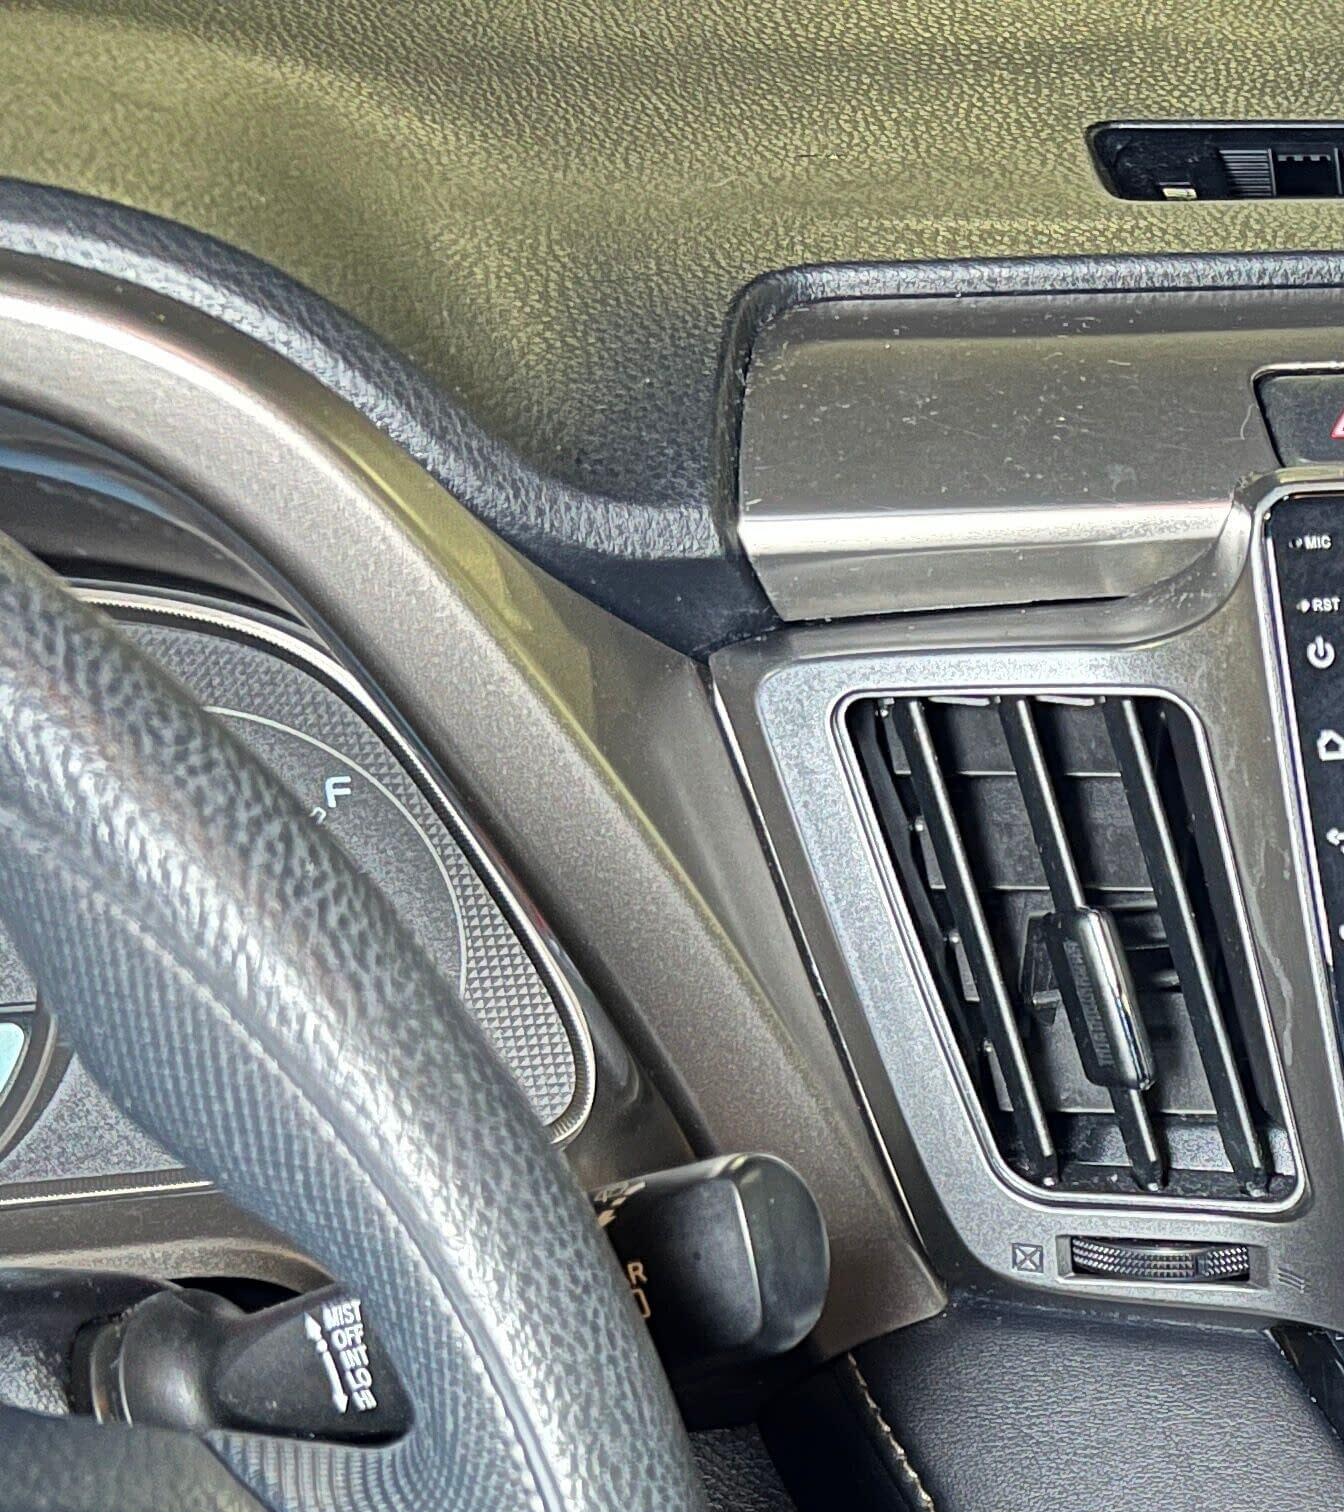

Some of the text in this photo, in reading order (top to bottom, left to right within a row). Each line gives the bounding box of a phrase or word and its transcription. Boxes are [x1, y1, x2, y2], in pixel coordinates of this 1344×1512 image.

[1303, 534, 1332, 550] MIC
[1312, 597, 1341, 612] RST
[325, 775, 352, 808] F
[322, 1299, 362, 1331] MIST
[331, 1323, 364, 1350] OFF
[339, 1344, 369, 1371] INT
[346, 1367, 373, 1390] LO
